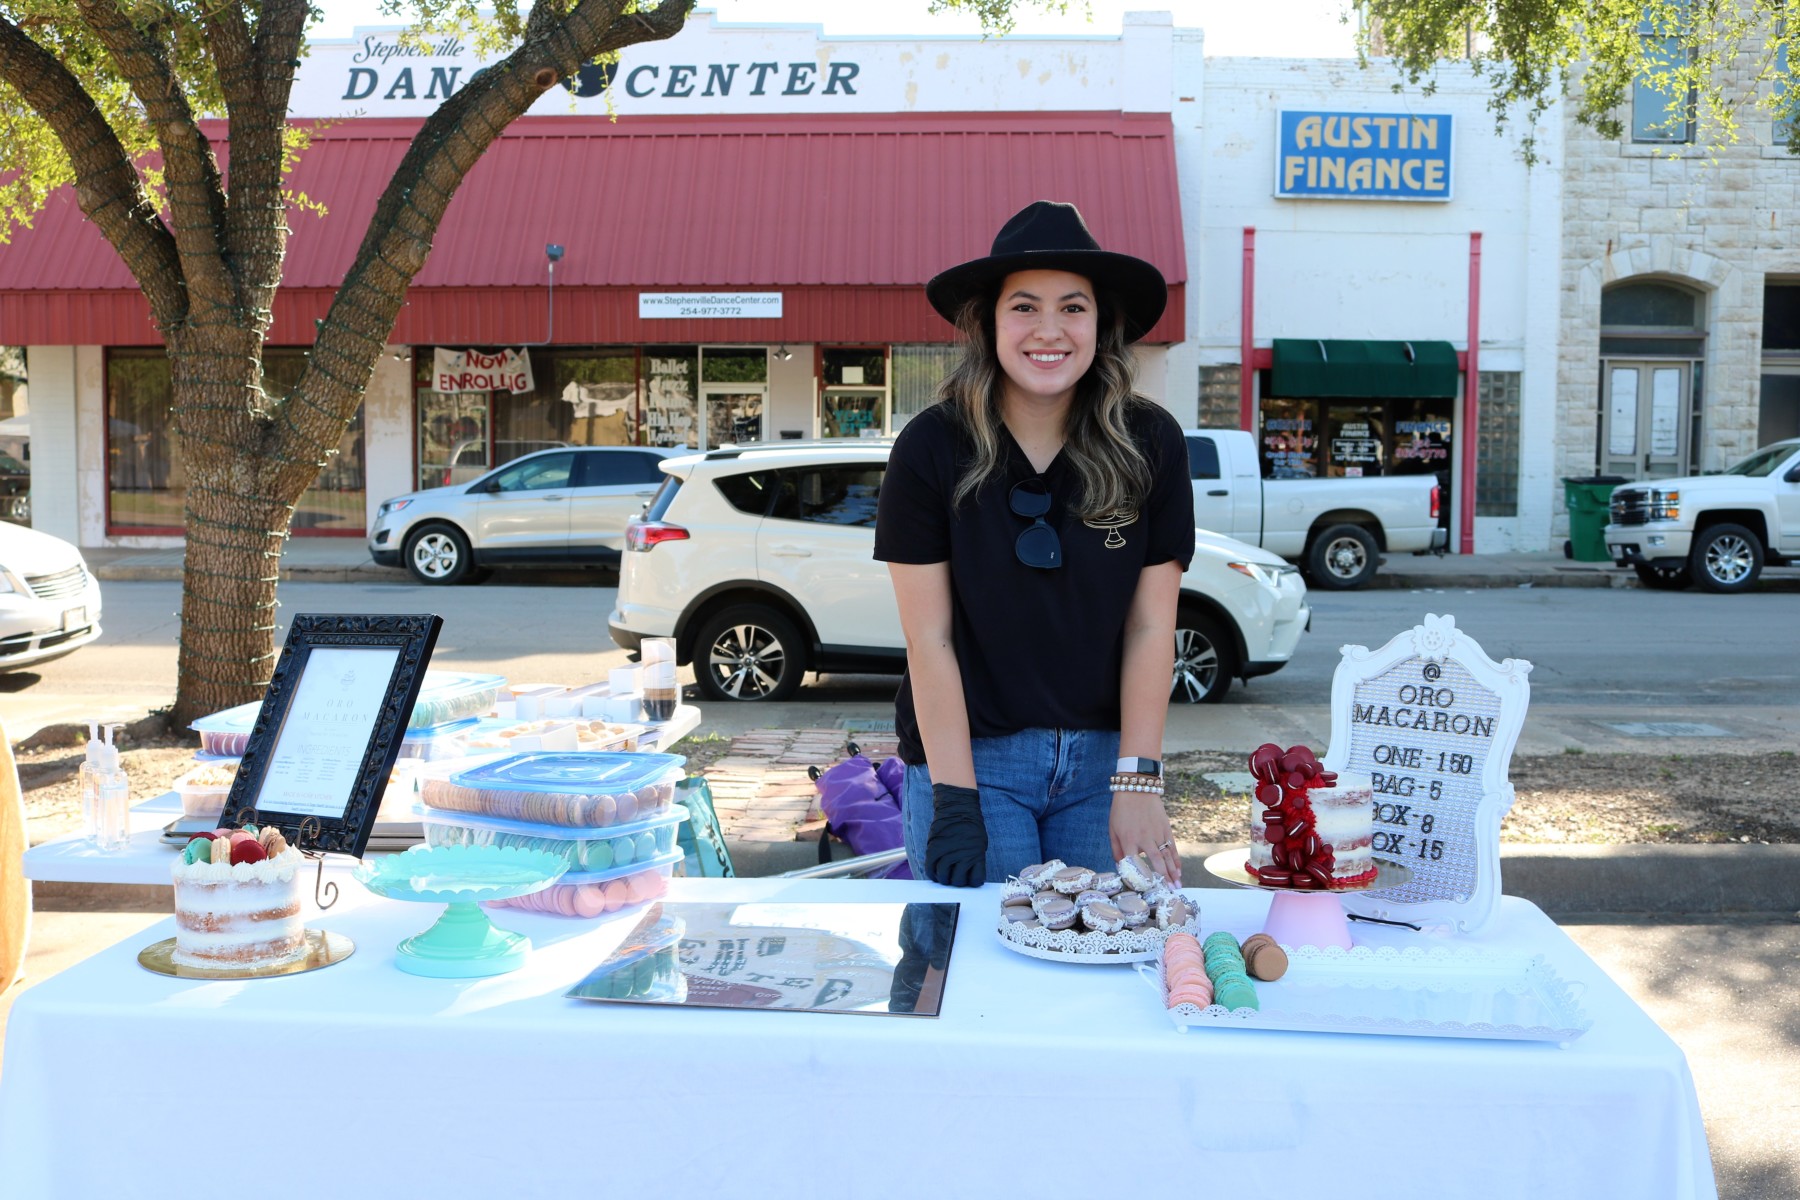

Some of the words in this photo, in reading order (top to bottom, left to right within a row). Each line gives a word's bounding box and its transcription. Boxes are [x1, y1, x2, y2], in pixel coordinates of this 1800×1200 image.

[342, 66, 490, 100] DAN
[625, 62, 860, 98] CENTER
[1294, 116, 1438, 150] AUSTIN
[1284, 157, 1446, 191] FINANCE
[642, 295, 780, 306] www.StephenvilleDanceCenter.com
[680, 307, 742, 315] 254-977-3772
[465, 350, 508, 370] NOW
[649, 357, 689, 374] Ballet
[649, 375, 688, 391] Jazz
[648, 412, 667, 429] Hip
[670, 412, 691, 428] Hop
[1395, 421, 1449, 433] FINANCE
[1423, 662, 1441, 682] @
[326, 698, 354, 708] ORO
[1400, 684, 1454, 709] ORO
[303, 711, 369, 723] MACARON
[1351, 703, 1495, 738] MACARON
[1371, 830, 1445, 861] OX-15
